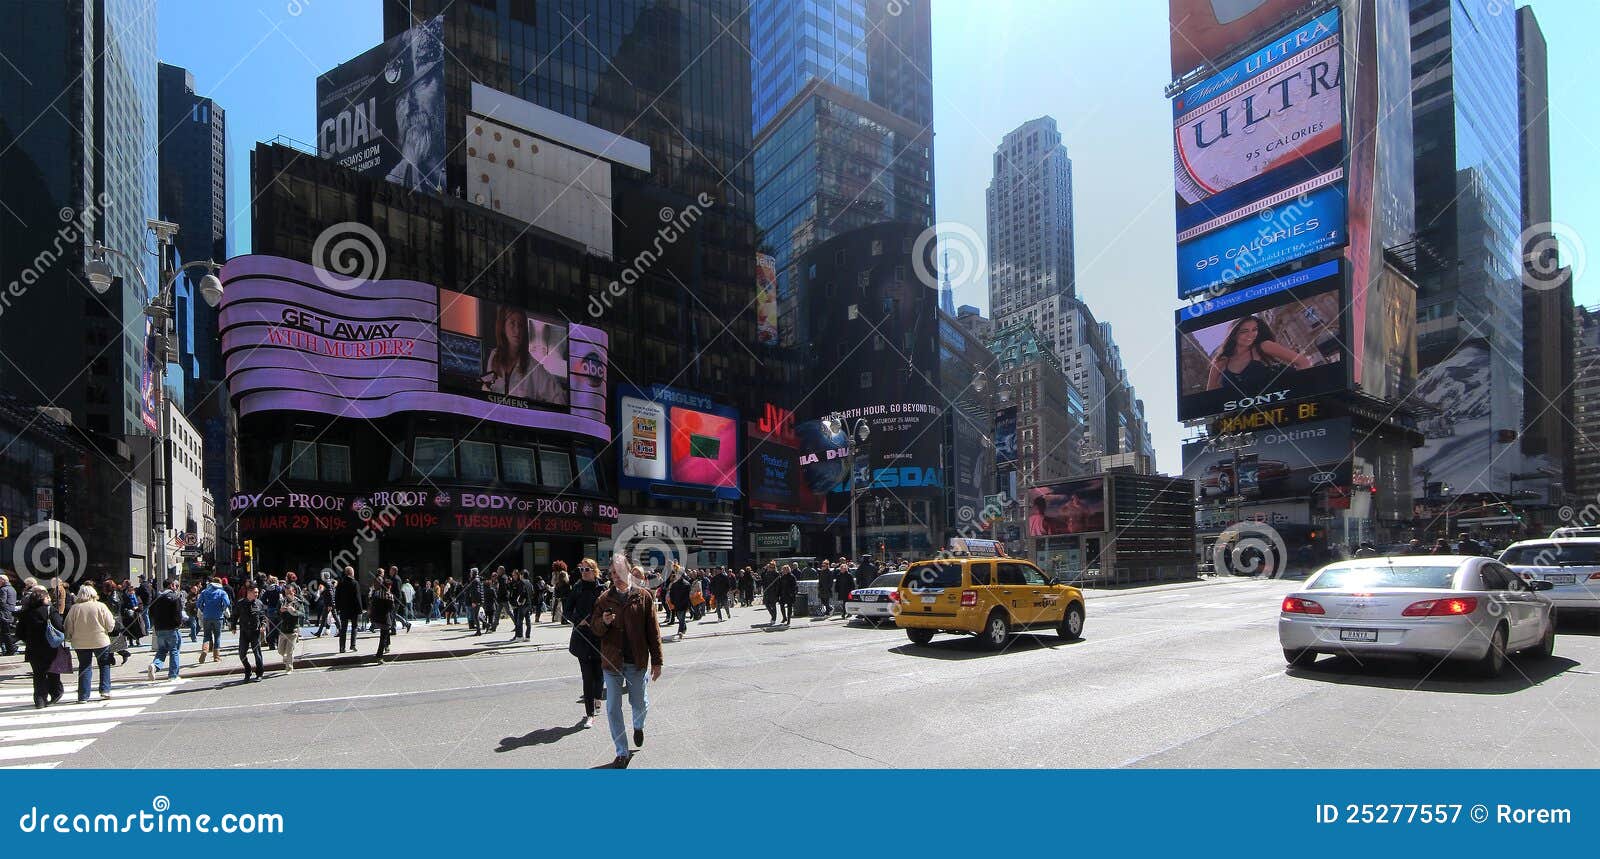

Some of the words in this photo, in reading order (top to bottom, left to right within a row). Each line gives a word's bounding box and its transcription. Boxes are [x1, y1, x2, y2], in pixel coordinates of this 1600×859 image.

[1246, 22, 1330, 73] ULTRA
[1192, 61, 1340, 149] ULTR
[320, 96, 382, 160] COAL
[1246, 149, 1260, 161] 95
[1265, 121, 1324, 152] CALORIES
[1195, 255, 1219, 271] 95
[1225, 218, 1320, 259] CALORIES
[1245, 274, 1309, 298] Corporation
[282, 308, 330, 335] GET
[333, 323, 400, 340] AWAY
[267, 327, 318, 352] WITH
[324, 340, 414, 358] MURDER?
[582, 359, 605, 377] abc
[488, 394, 529, 409] SIEMENS
[863, 405, 888, 416] HOUR,
[890, 403, 901, 413] GO
[903, 403, 928, 414] BEYOND
[1223, 389, 1291, 412] SONY
[759, 402, 796, 437] JVC
[1264, 428, 1327, 446] Optima
[263, 496, 285, 508] OF
[288, 493, 345, 511] PROOF
[373, 491, 427, 507] PROOF
[461, 493, 518, 510] BODY
[517, 500, 535, 511] OF
[537, 498, 578, 514] PROOF
[259, 515, 287, 529] MAR
[292, 515, 309, 529] 29
[455, 514, 513, 529] TUESDAY
[632, 524, 699, 538] SEPHORA
